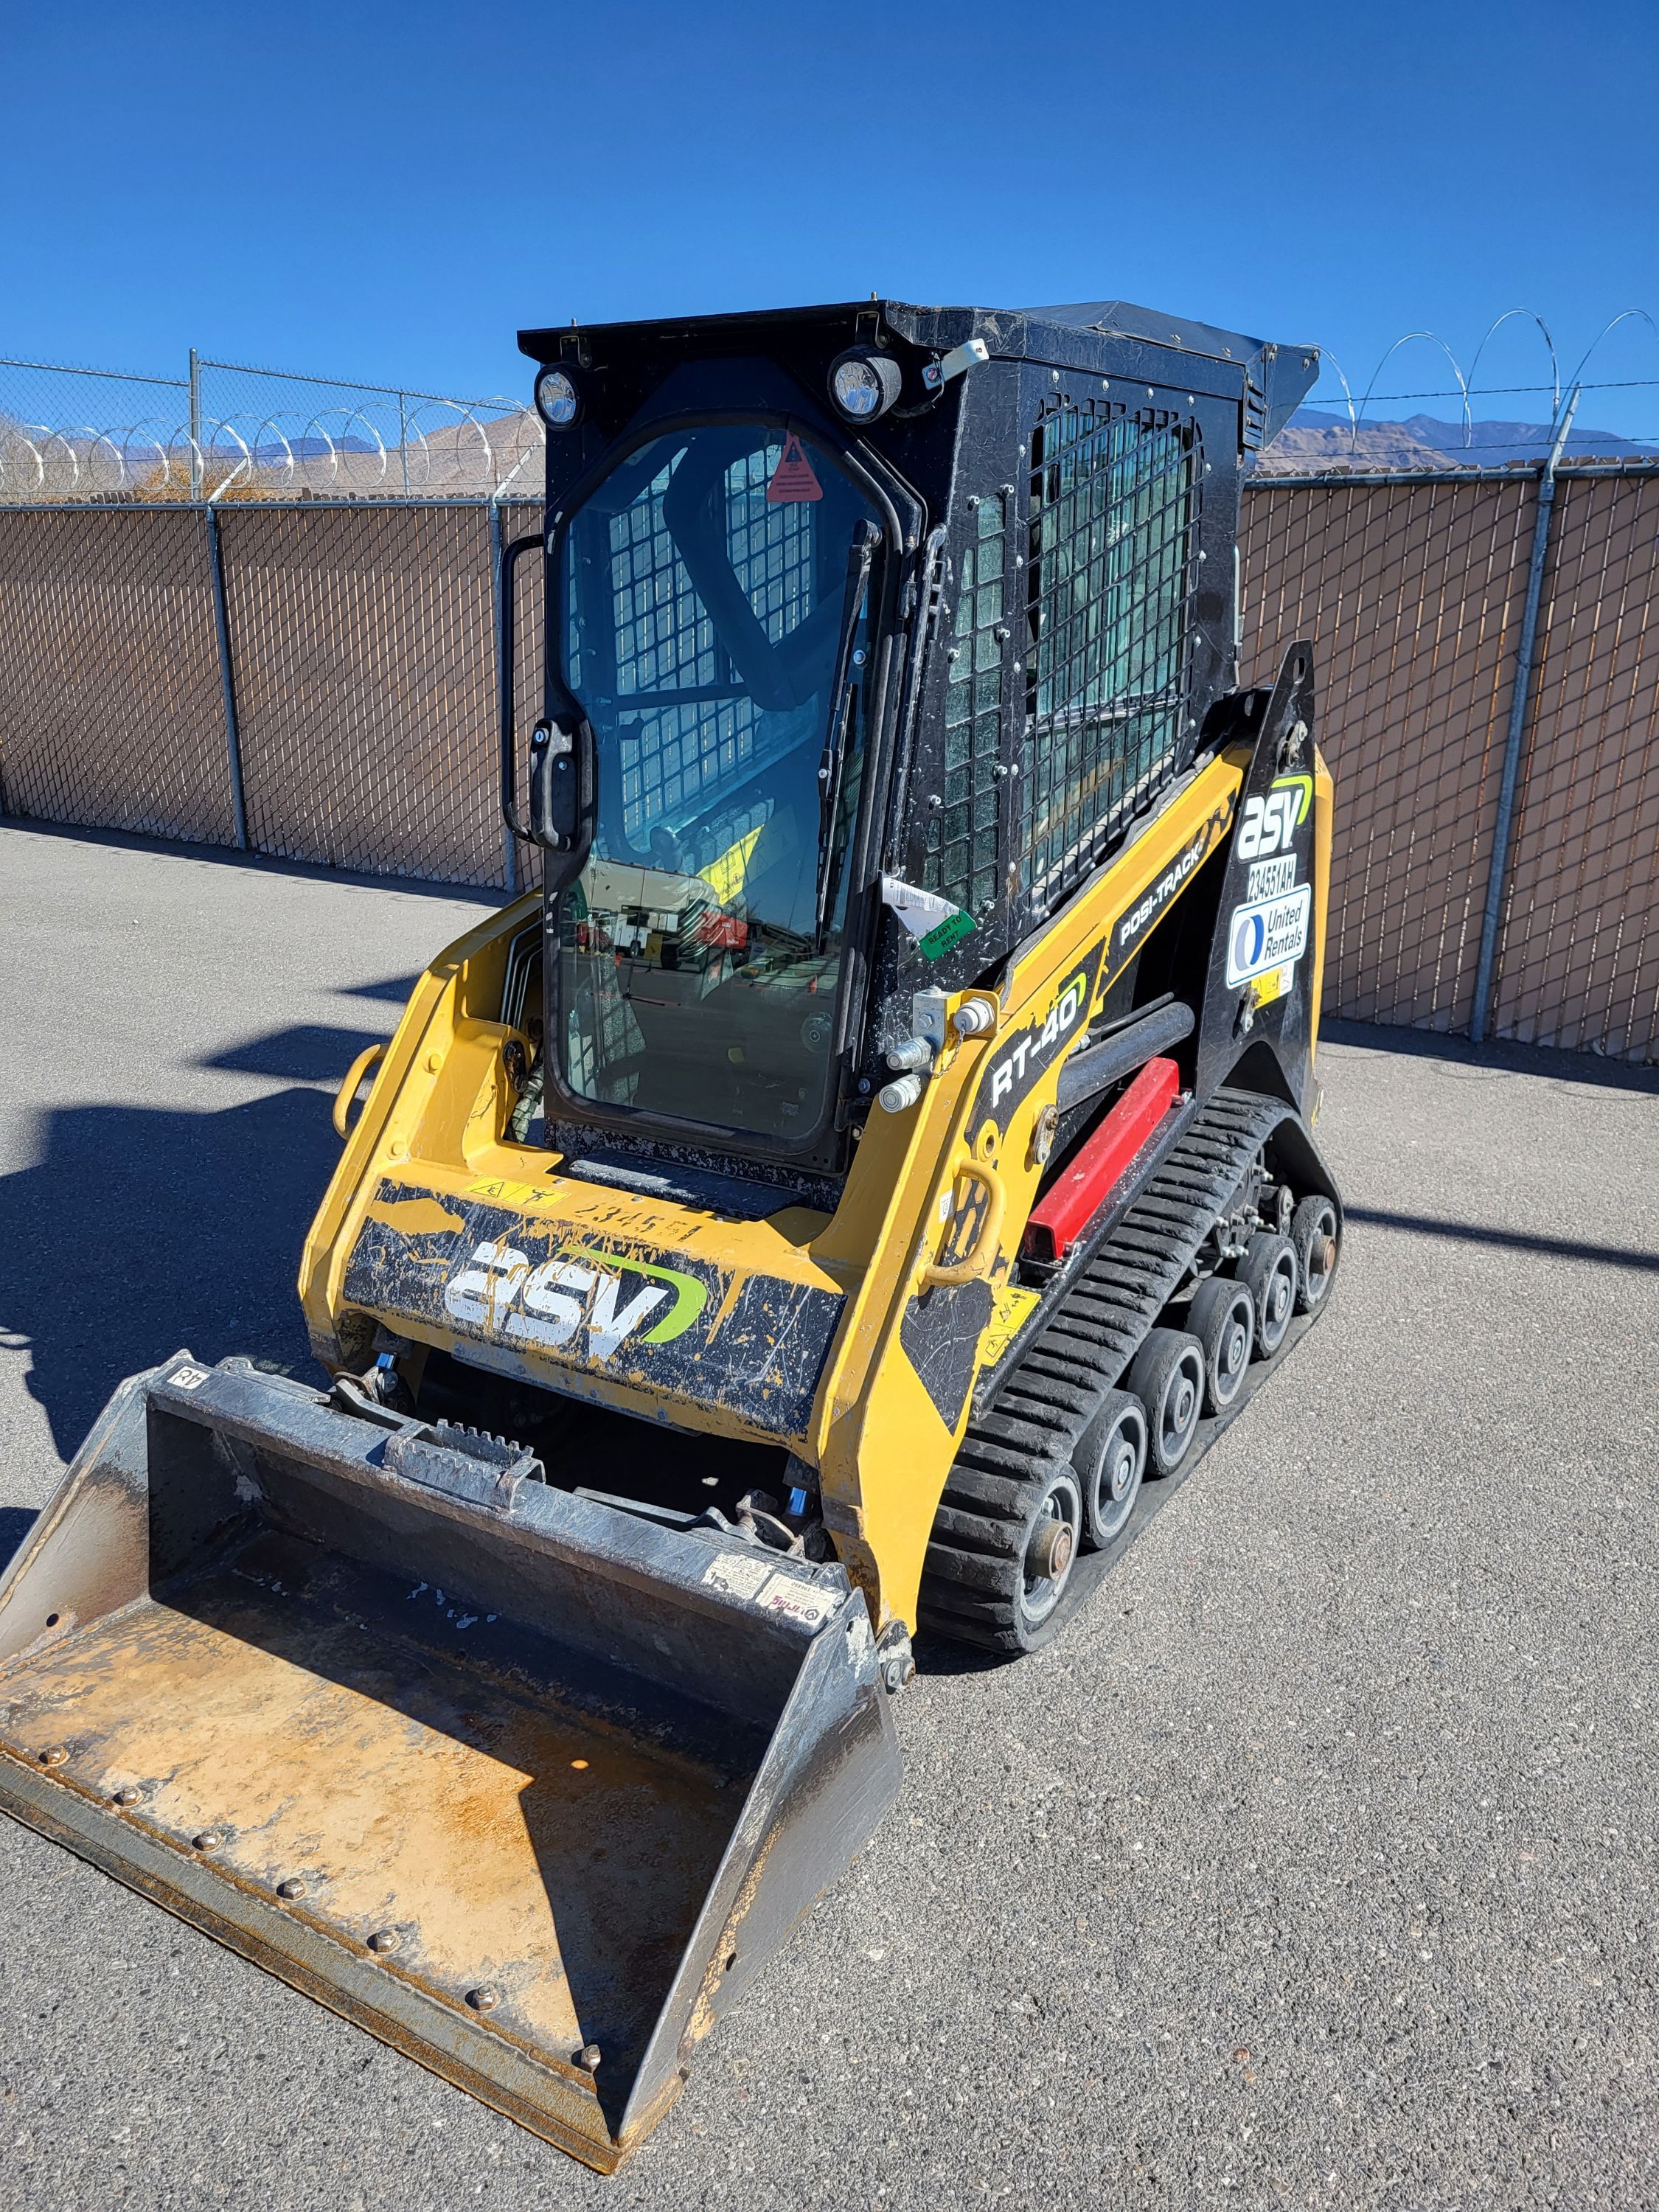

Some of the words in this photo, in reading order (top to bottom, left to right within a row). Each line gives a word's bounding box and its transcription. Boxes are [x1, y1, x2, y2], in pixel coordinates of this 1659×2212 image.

[1121, 845, 1200, 947] POSI-TRACK
[1247, 860, 1294, 902] 234551AH
[928, 924, 951, 945] READY
[951, 916, 962, 926] TO
[1268, 900, 1301, 933] United
[941, 930, 959, 947] RENT
[1265, 929, 1302, 961] Rentals
[992, 987, 1077, 1108] RT-40
